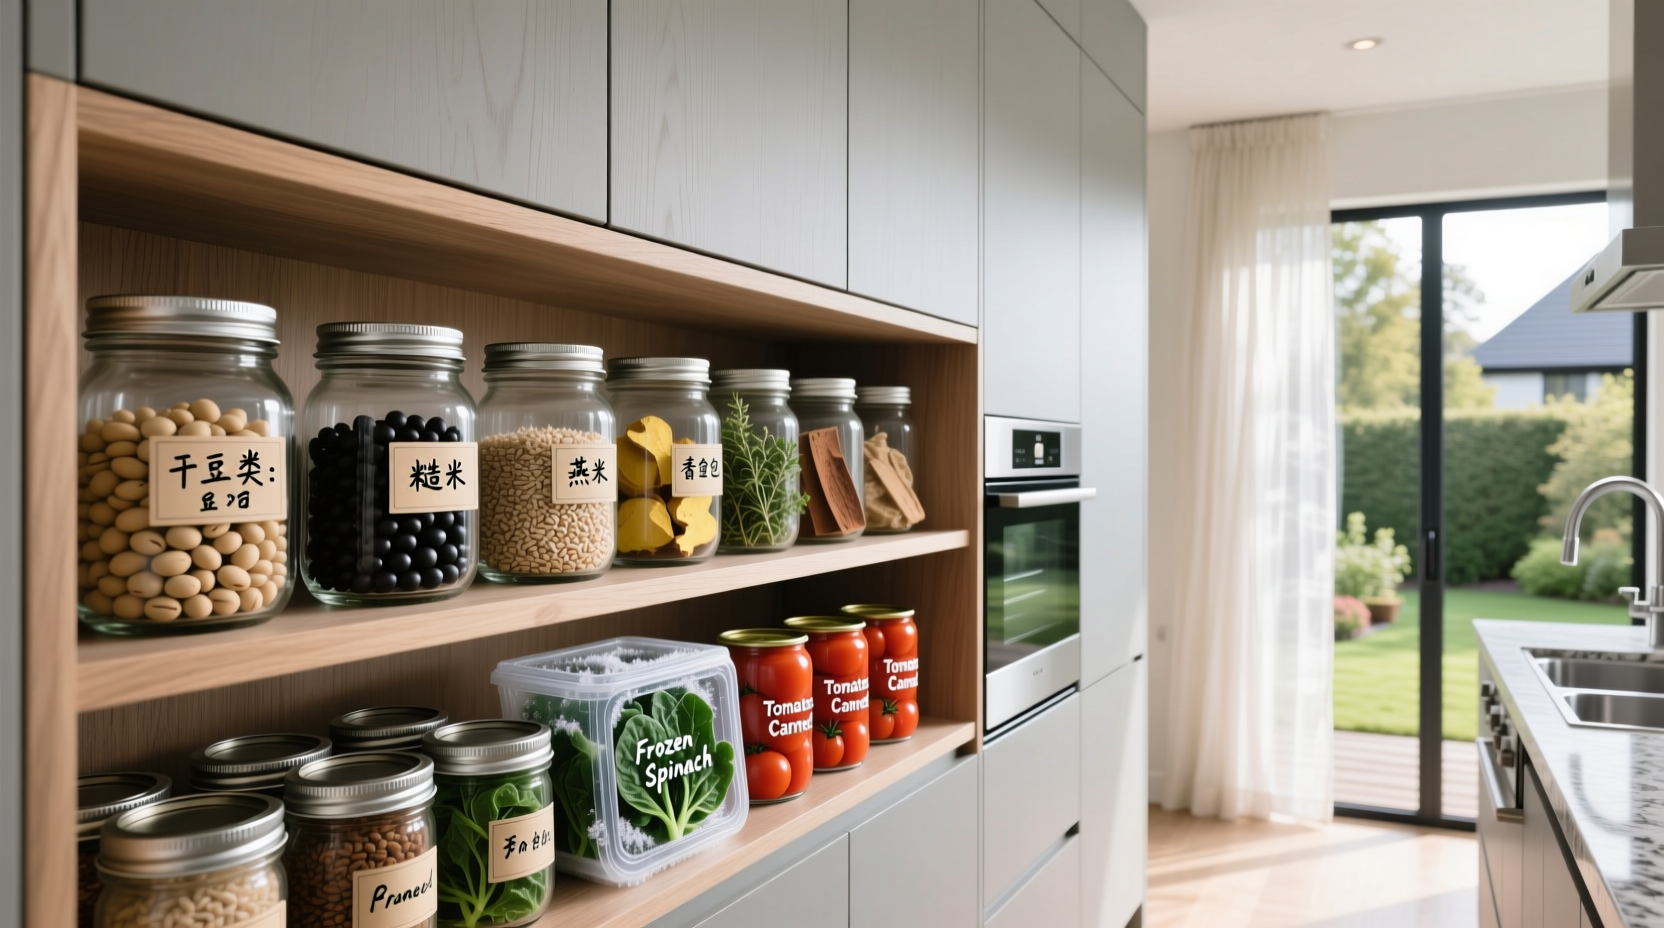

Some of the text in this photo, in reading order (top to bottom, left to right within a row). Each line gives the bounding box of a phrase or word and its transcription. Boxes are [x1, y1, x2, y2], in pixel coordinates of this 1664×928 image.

[409, 458, 466, 492] 糙米
[635, 734, 693, 766] Frozen
[645, 744, 712, 795] Spinach
